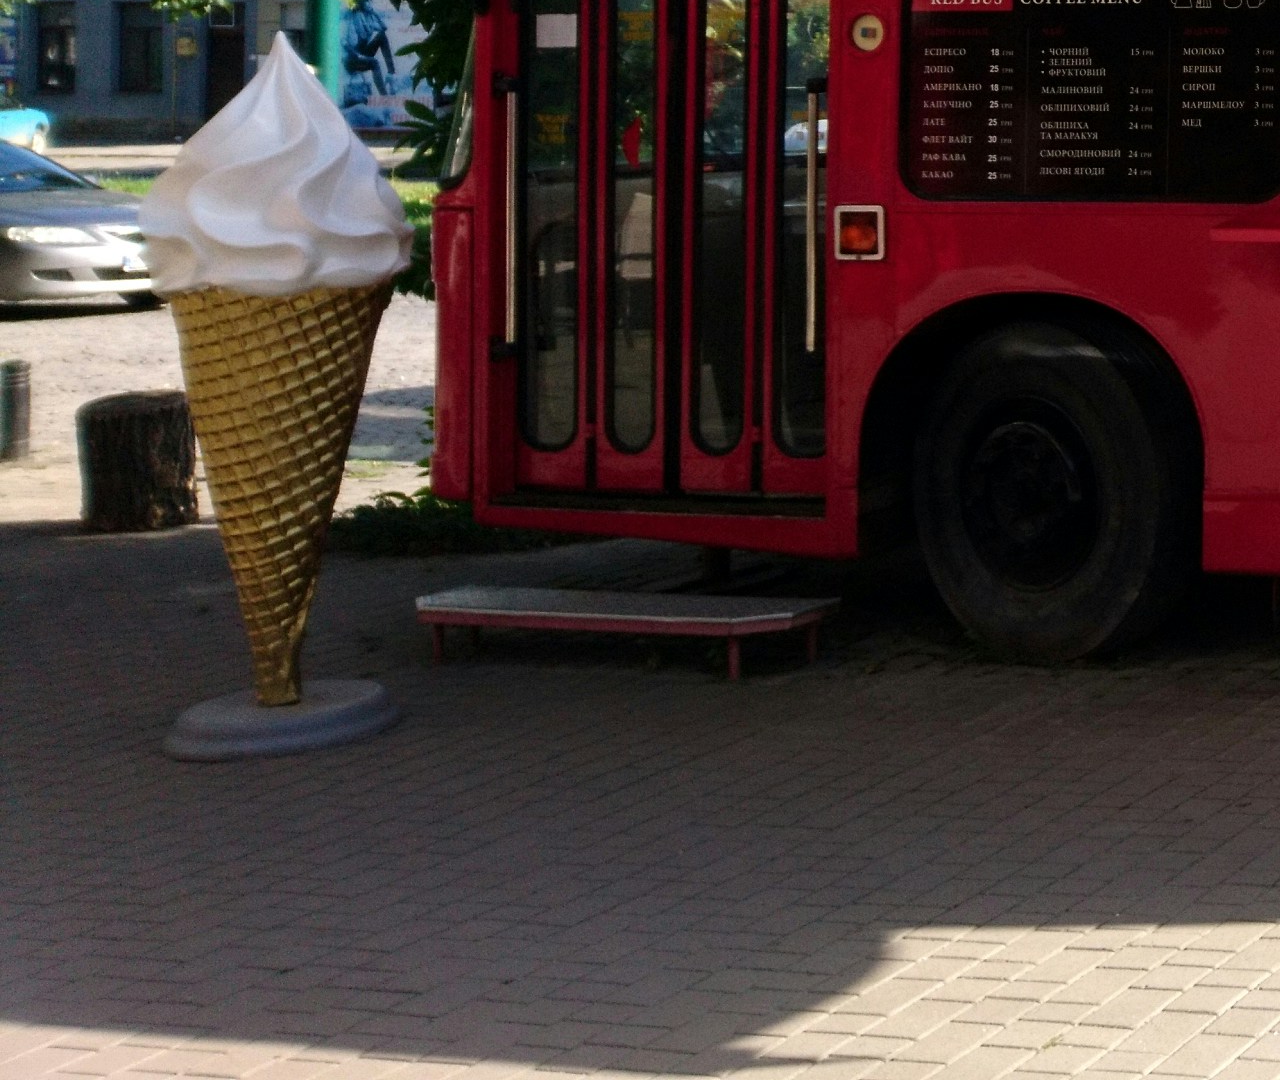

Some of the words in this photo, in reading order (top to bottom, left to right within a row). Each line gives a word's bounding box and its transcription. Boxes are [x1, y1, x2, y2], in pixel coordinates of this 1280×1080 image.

[1049, 47, 1089, 56] ЧОРНИЙ
[1049, 57, 1092, 66] ЗЕЛЕНИЙ
[1049, 68, 1106, 76] ФРУКТОВИЙ
[1041, 85, 1103, 94] МАЛИНОВИЙ
[1182, 101, 1245, 109] МАРШМЕЛОУ
[923, 118, 946, 126] ЛАТЕ
[1182, 119, 1202, 127] МЕД
[1254, 119, 1259, 127] 3
[949, 135, 973, 143] ВАЙТ
[1040, 132, 1052, 140] ТА
[1055, 132, 1098, 140] МАРАКУЯ
[1040, 149, 1121, 158] СМОРОДИНОВИЙ
